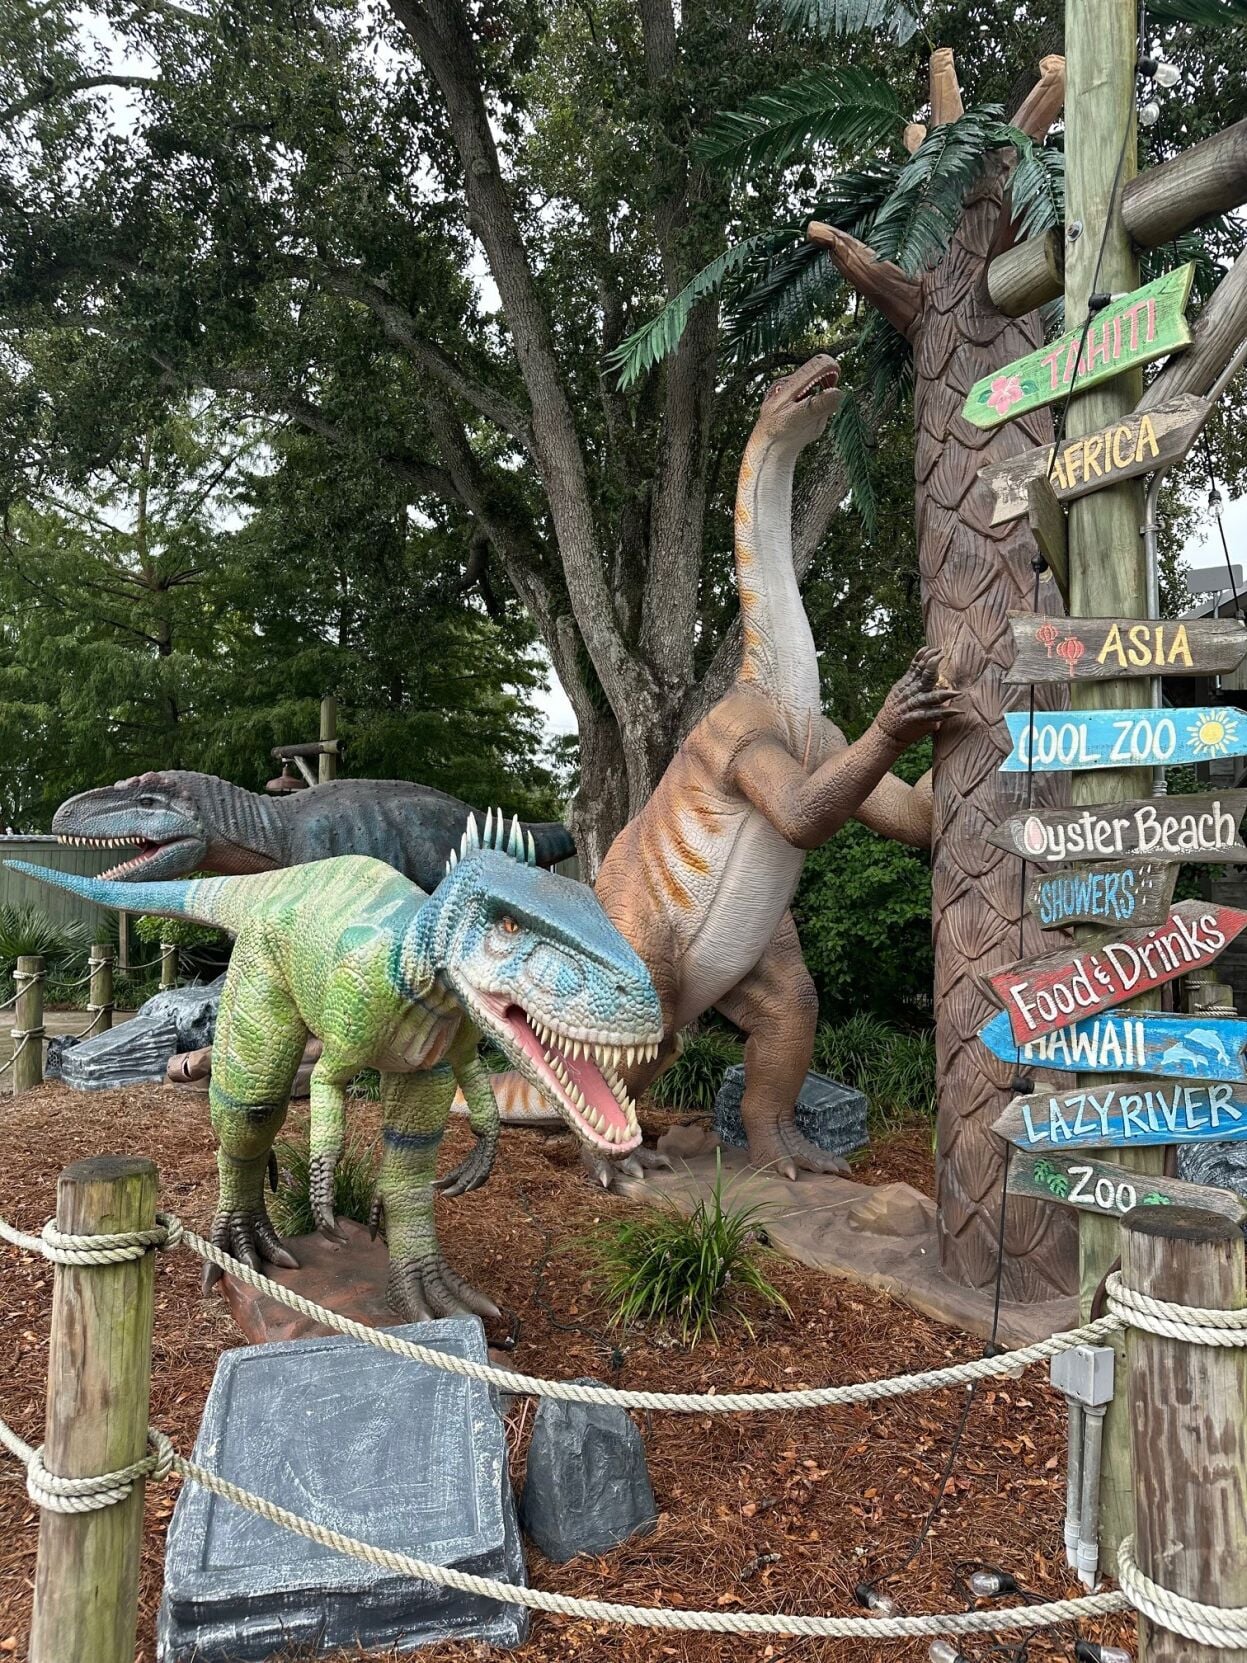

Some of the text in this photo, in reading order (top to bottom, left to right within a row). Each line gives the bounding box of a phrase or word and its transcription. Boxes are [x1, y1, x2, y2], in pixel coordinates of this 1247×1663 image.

[1041, 298, 1155, 390] TAHITI
[1047, 415, 1160, 490] AFRICA
[1097, 623, 1194, 667] ASIA
[1018, 718, 1177, 765] COOL ZOO
[1023, 801, 1236, 861] Oyster Beach
[1040, 868, 1136, 924] SHOWERS
[1010, 959, 1101, 1031] Food
[1103, 914, 1226, 991] Drinks
[1022, 1083, 1243, 1143] LAZY RIVER
